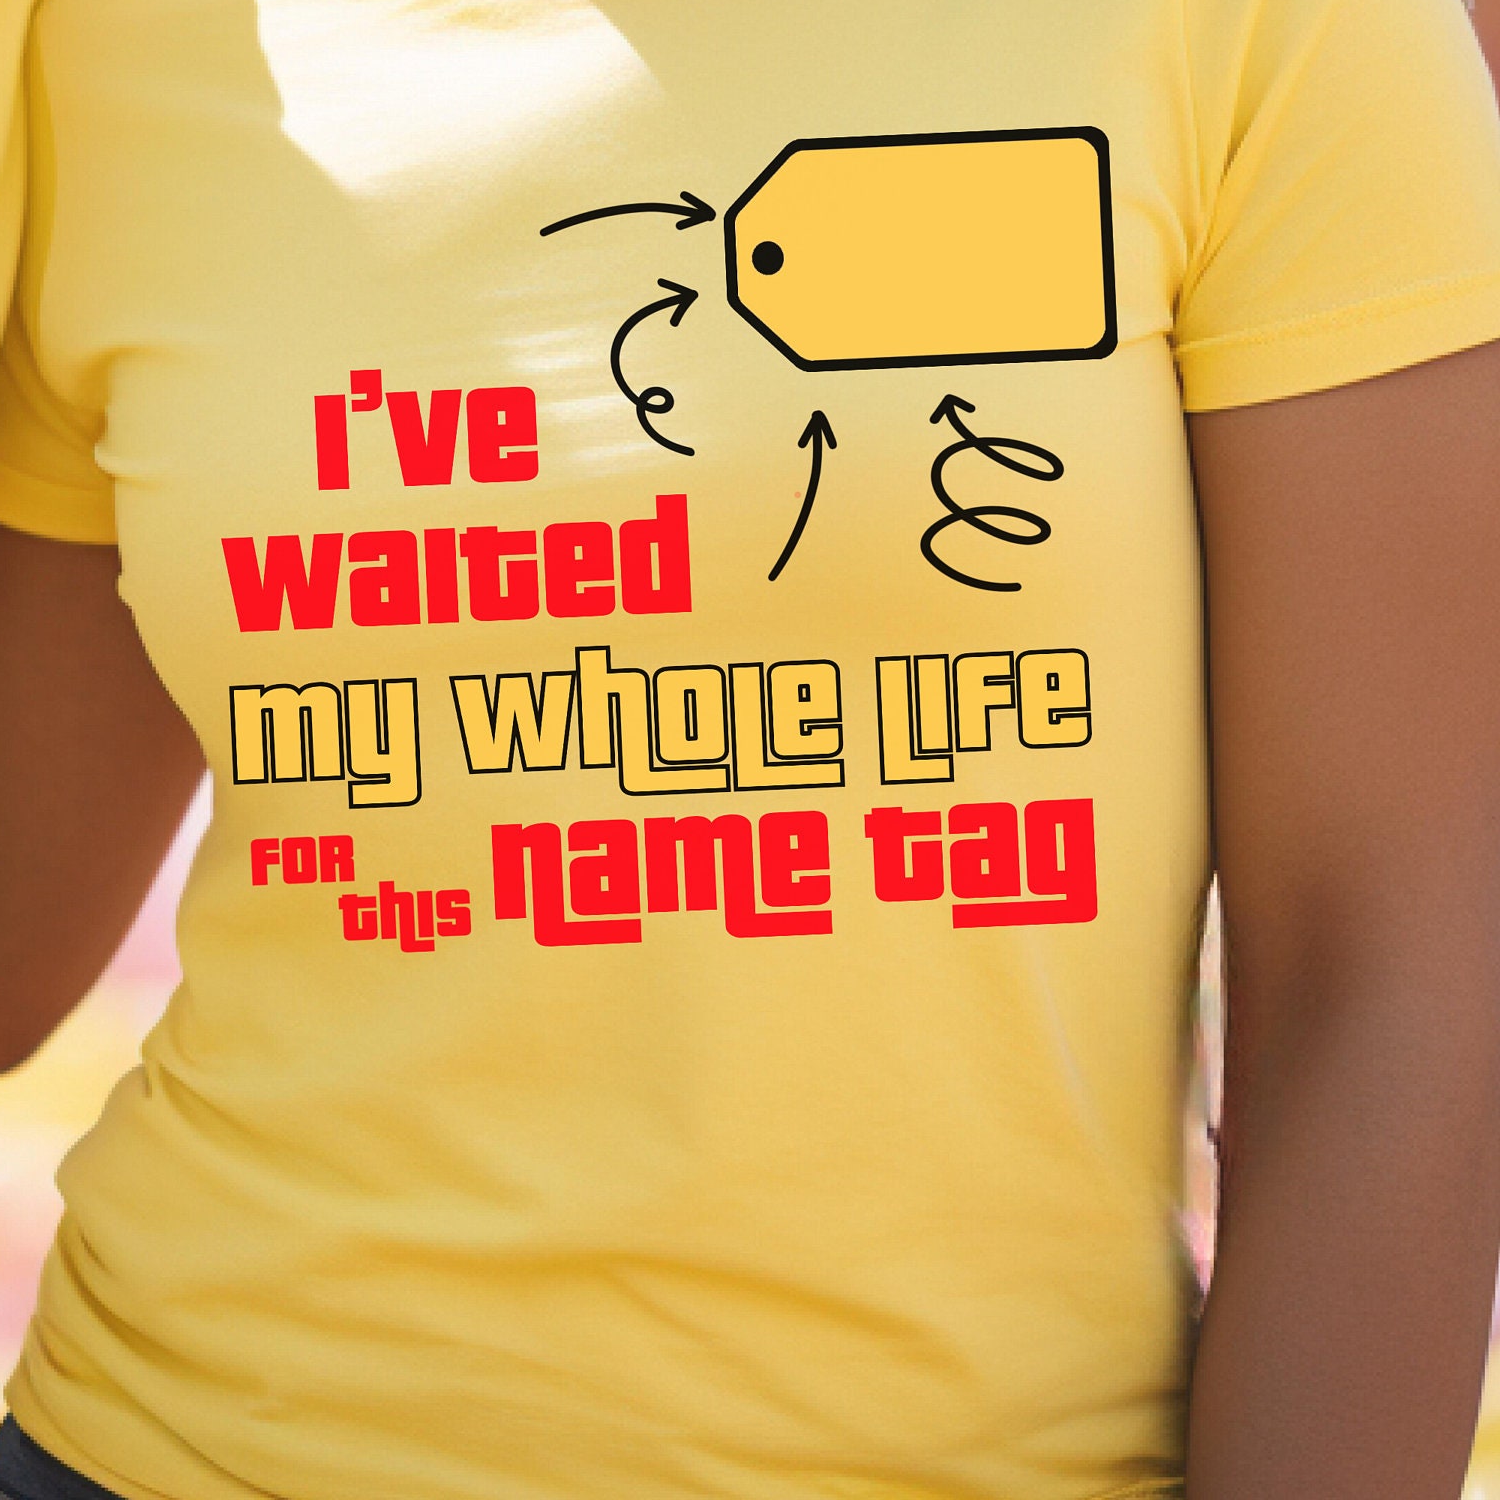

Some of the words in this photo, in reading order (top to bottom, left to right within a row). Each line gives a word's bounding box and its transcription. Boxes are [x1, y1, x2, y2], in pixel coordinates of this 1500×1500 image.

[229, 677, 422, 809] my
[491, 810, 833, 947] name
[864, 798, 1098, 929] tag
